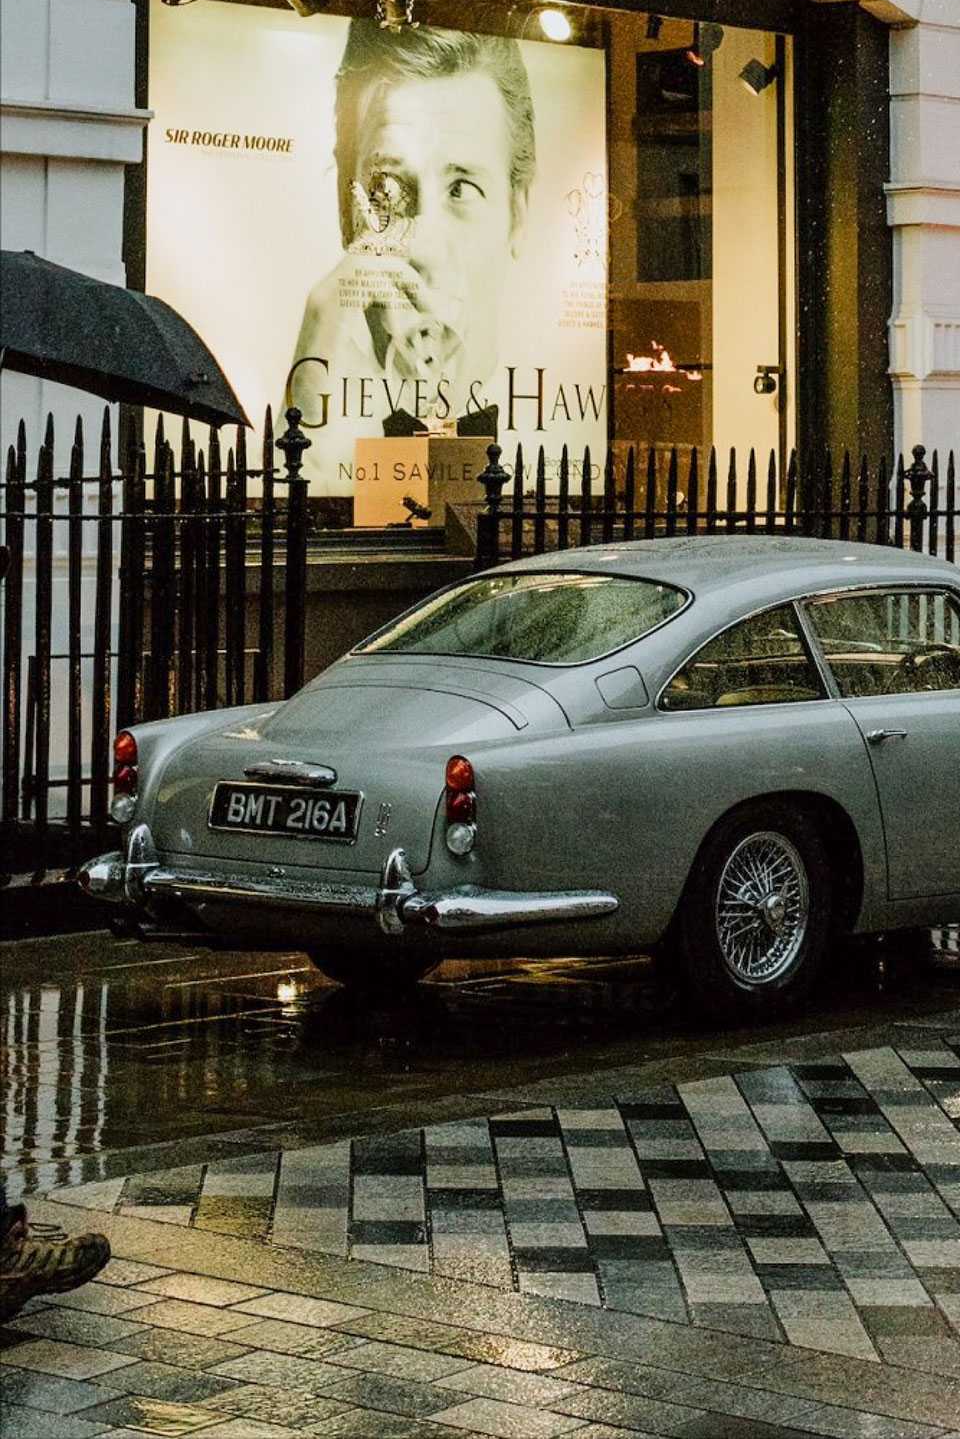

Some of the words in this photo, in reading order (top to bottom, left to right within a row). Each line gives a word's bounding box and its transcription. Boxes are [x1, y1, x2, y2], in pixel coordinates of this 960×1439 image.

[165, 128, 190, 144] SIR
[191, 130, 241, 149] ROGER
[243, 135, 295, 152] MOORE
[286, 357, 451, 429] GIEVES
[466, 380, 489, 412] &
[339, 462, 380, 480] No.1
[393, 462, 474, 481] SAVILE
[227, 792, 283, 827] BMT
[286, 798, 347, 832] 216A
